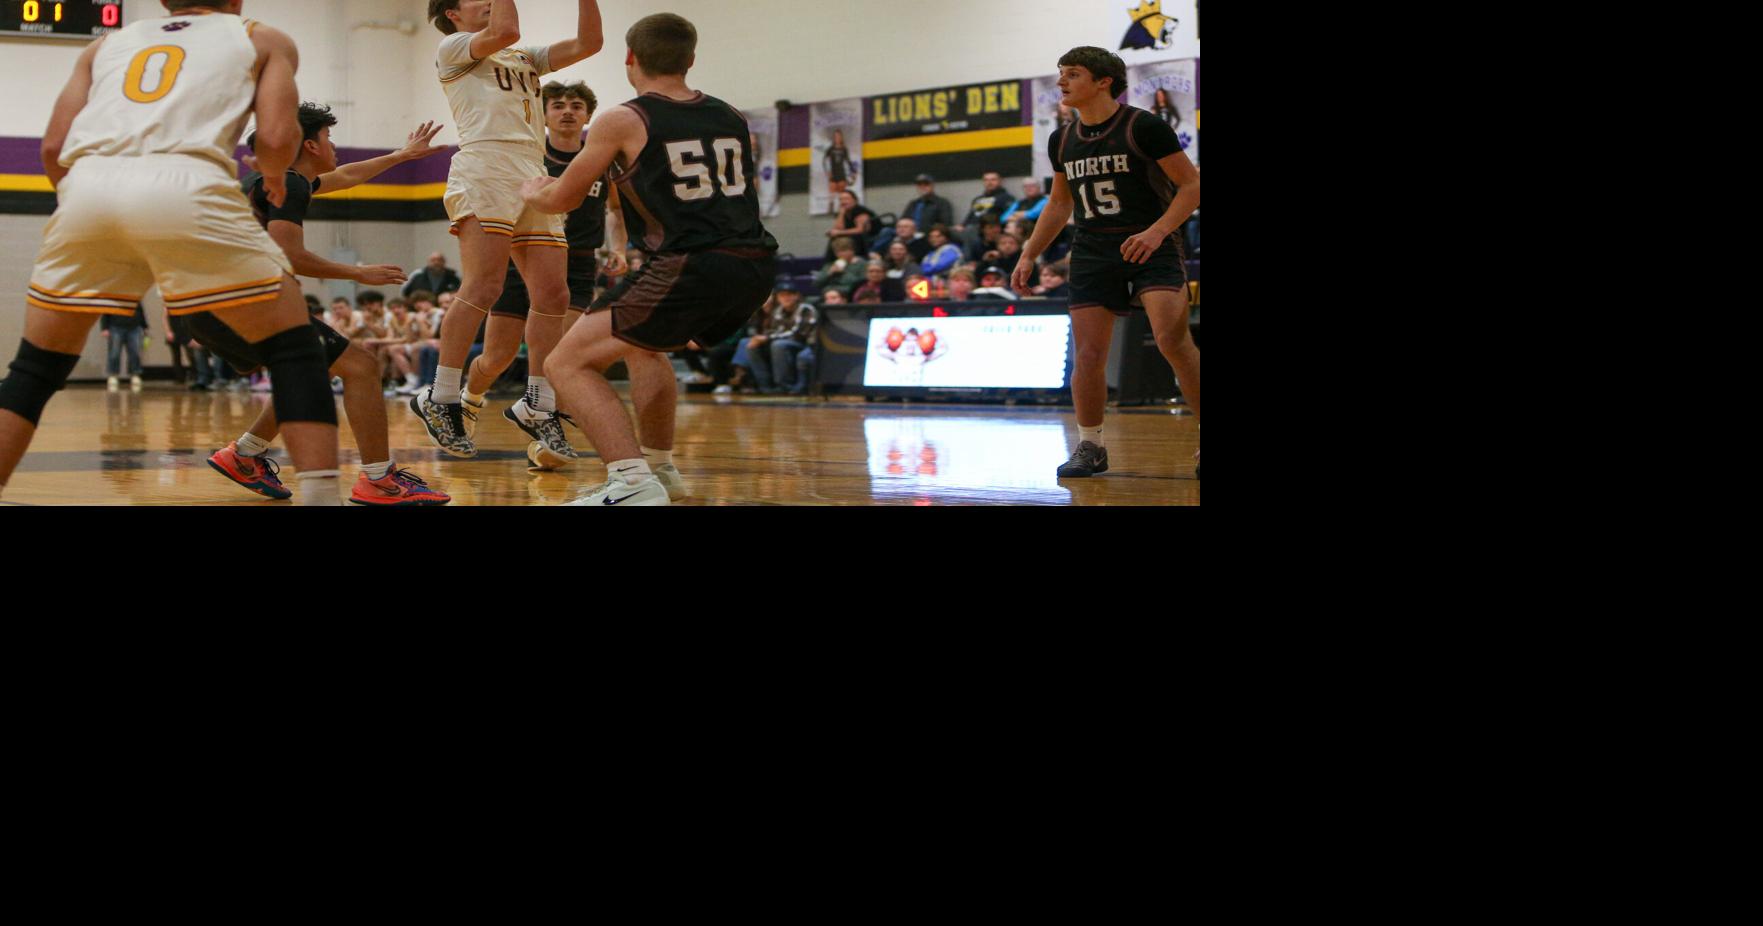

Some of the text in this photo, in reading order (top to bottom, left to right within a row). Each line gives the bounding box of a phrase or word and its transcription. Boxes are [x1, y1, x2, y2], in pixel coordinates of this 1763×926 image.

[102, 4, 118, 26] 0
[122, 44, 186, 103] 0
[522, 98, 531, 124] 1
[873, 90, 957, 125] LIONS'
[966, 82, 1020, 115] DEN
[665, 137, 746, 201] 50
[1064, 154, 1130, 180] NORTH
[1078, 180, 1121, 219] 15
